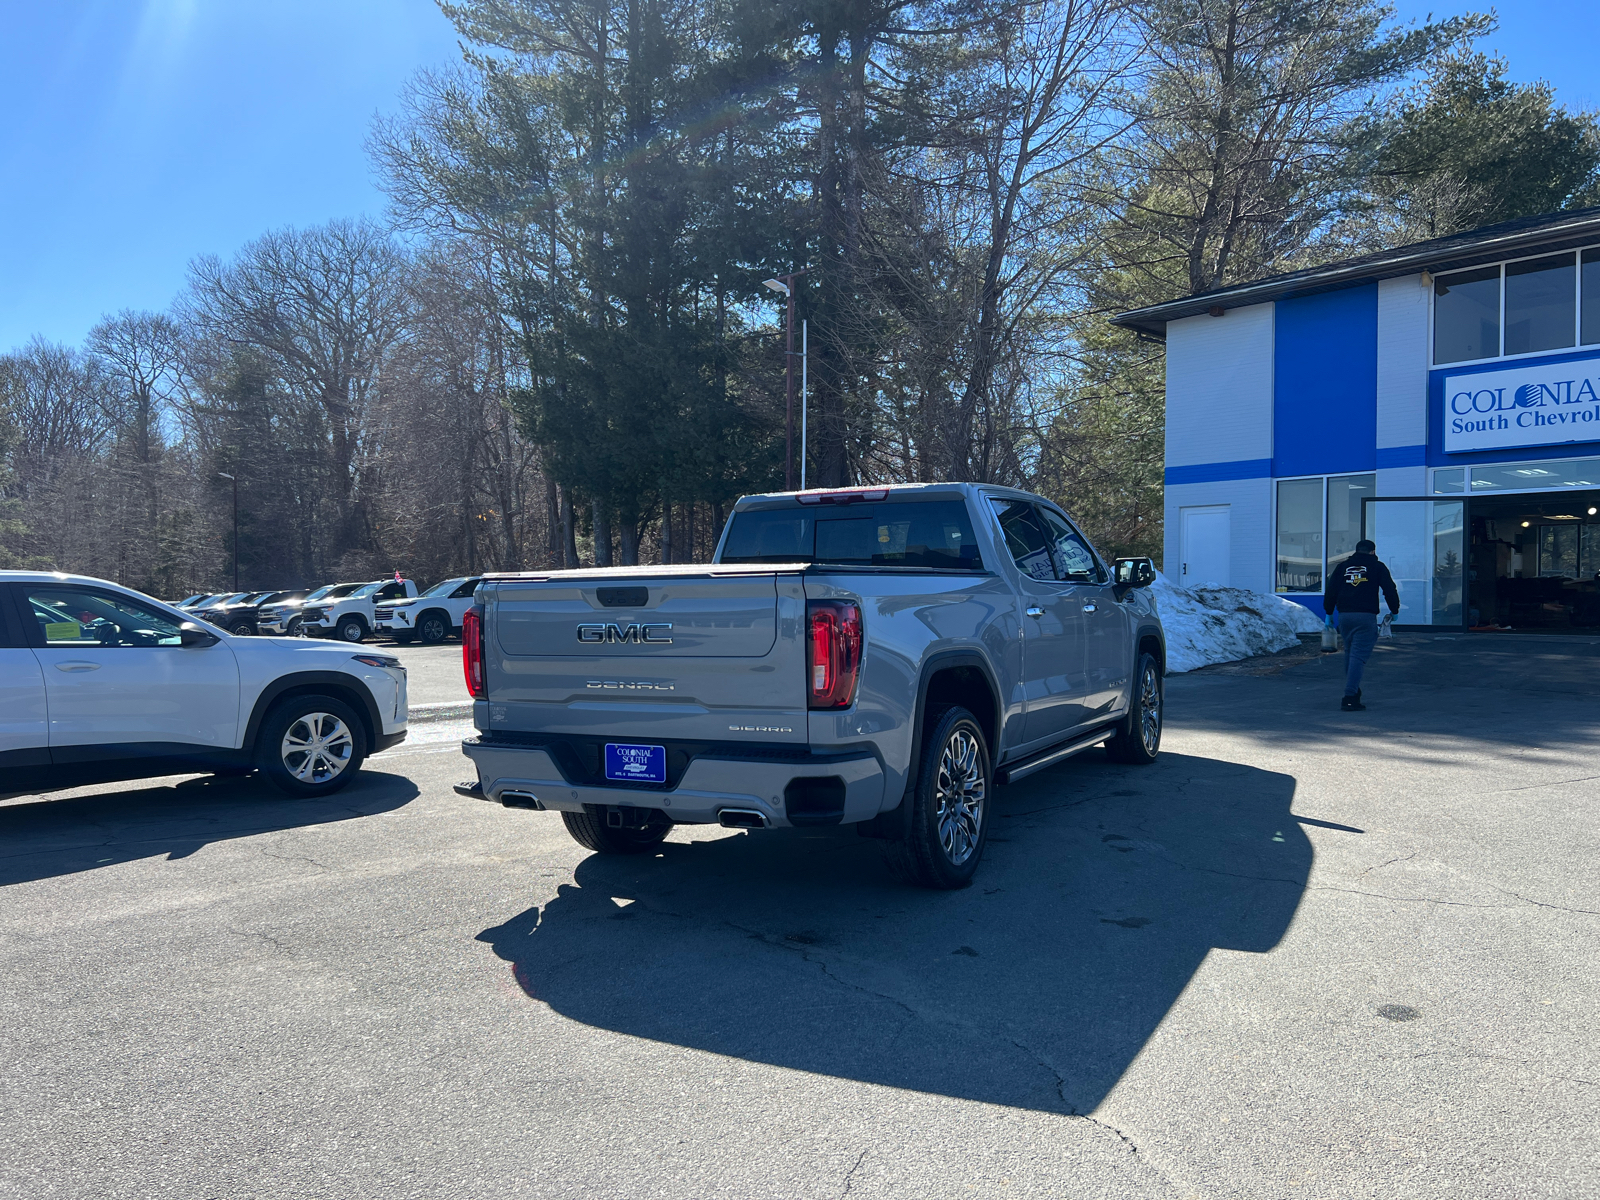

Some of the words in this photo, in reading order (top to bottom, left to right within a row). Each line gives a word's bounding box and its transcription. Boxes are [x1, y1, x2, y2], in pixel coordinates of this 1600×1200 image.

[1451, 377, 1600, 415] COLONIA
[1452, 414, 1509, 434] South
[577, 623, 673, 644] GMC
[586, 680, 675, 691] DENALI
[729, 724, 792, 733] SIERRA
[617, 748, 653, 757] COLONIAL
[622, 755, 647, 763] SOUTH
